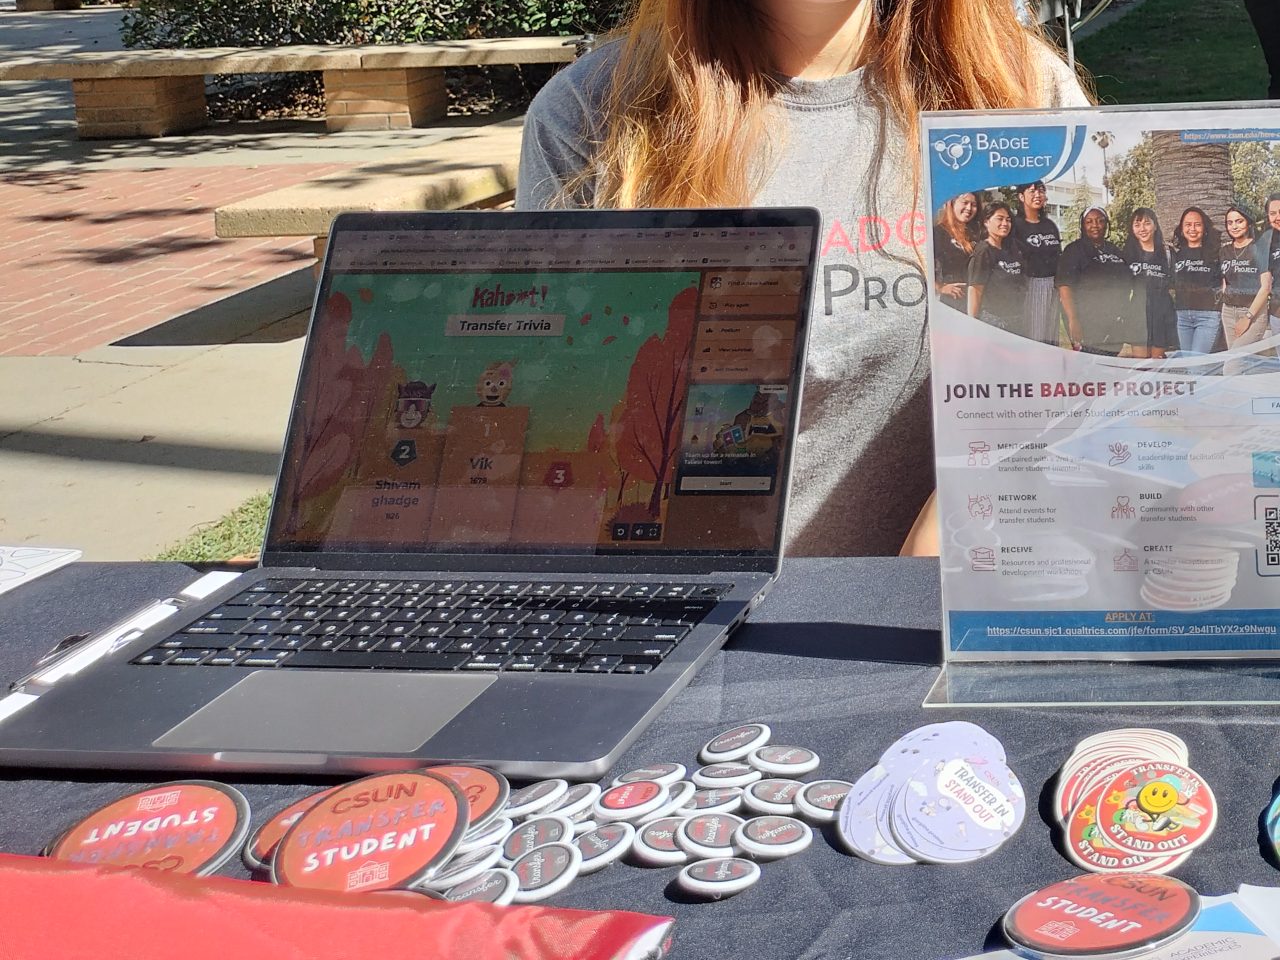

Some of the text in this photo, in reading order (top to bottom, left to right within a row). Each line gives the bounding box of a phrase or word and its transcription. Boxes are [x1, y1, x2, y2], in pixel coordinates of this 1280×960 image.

[976, 133, 1029, 150] BADGE
[989, 151, 1052, 168] PROJECT
[823, 263, 927, 316] PRO
[459, 319, 551, 332] Transfer Trivia
[944, 380, 1198, 402] JOIN THE BADGE PROJECT
[956, 408, 1082, 419] Connect with other Transfer
[398, 445, 410, 459] 2
[469, 457, 494, 471] Vik
[554, 469, 566, 484] 3
[998, 494, 1037, 502] NETWORK
[1139, 492, 1162, 500] BUILD
[1001, 546, 1033, 554] RECEIVE
[1143, 544, 1173, 552] CREATE
[1104, 611, 1135, 622] APPLY
[1130, 762, 1189, 779] TRANSFER
[331, 781, 418, 815] CSUN
[944, 779, 995, 823] STAND OUT
[953, 766, 1009, 818] TRANSFER IN
[80, 805, 219, 845] STUDENT
[299, 799, 446, 849] TRANSFER
[1110, 823, 1189, 851] STAND OUT
[302, 823, 437, 873] STUDENT
[1078, 839, 1119, 867] STAND
[1100, 875, 1179, 902] CSUN
[1060, 879, 1172, 923] TRANSFER
[1036, 896, 1142, 933] STUDENT
